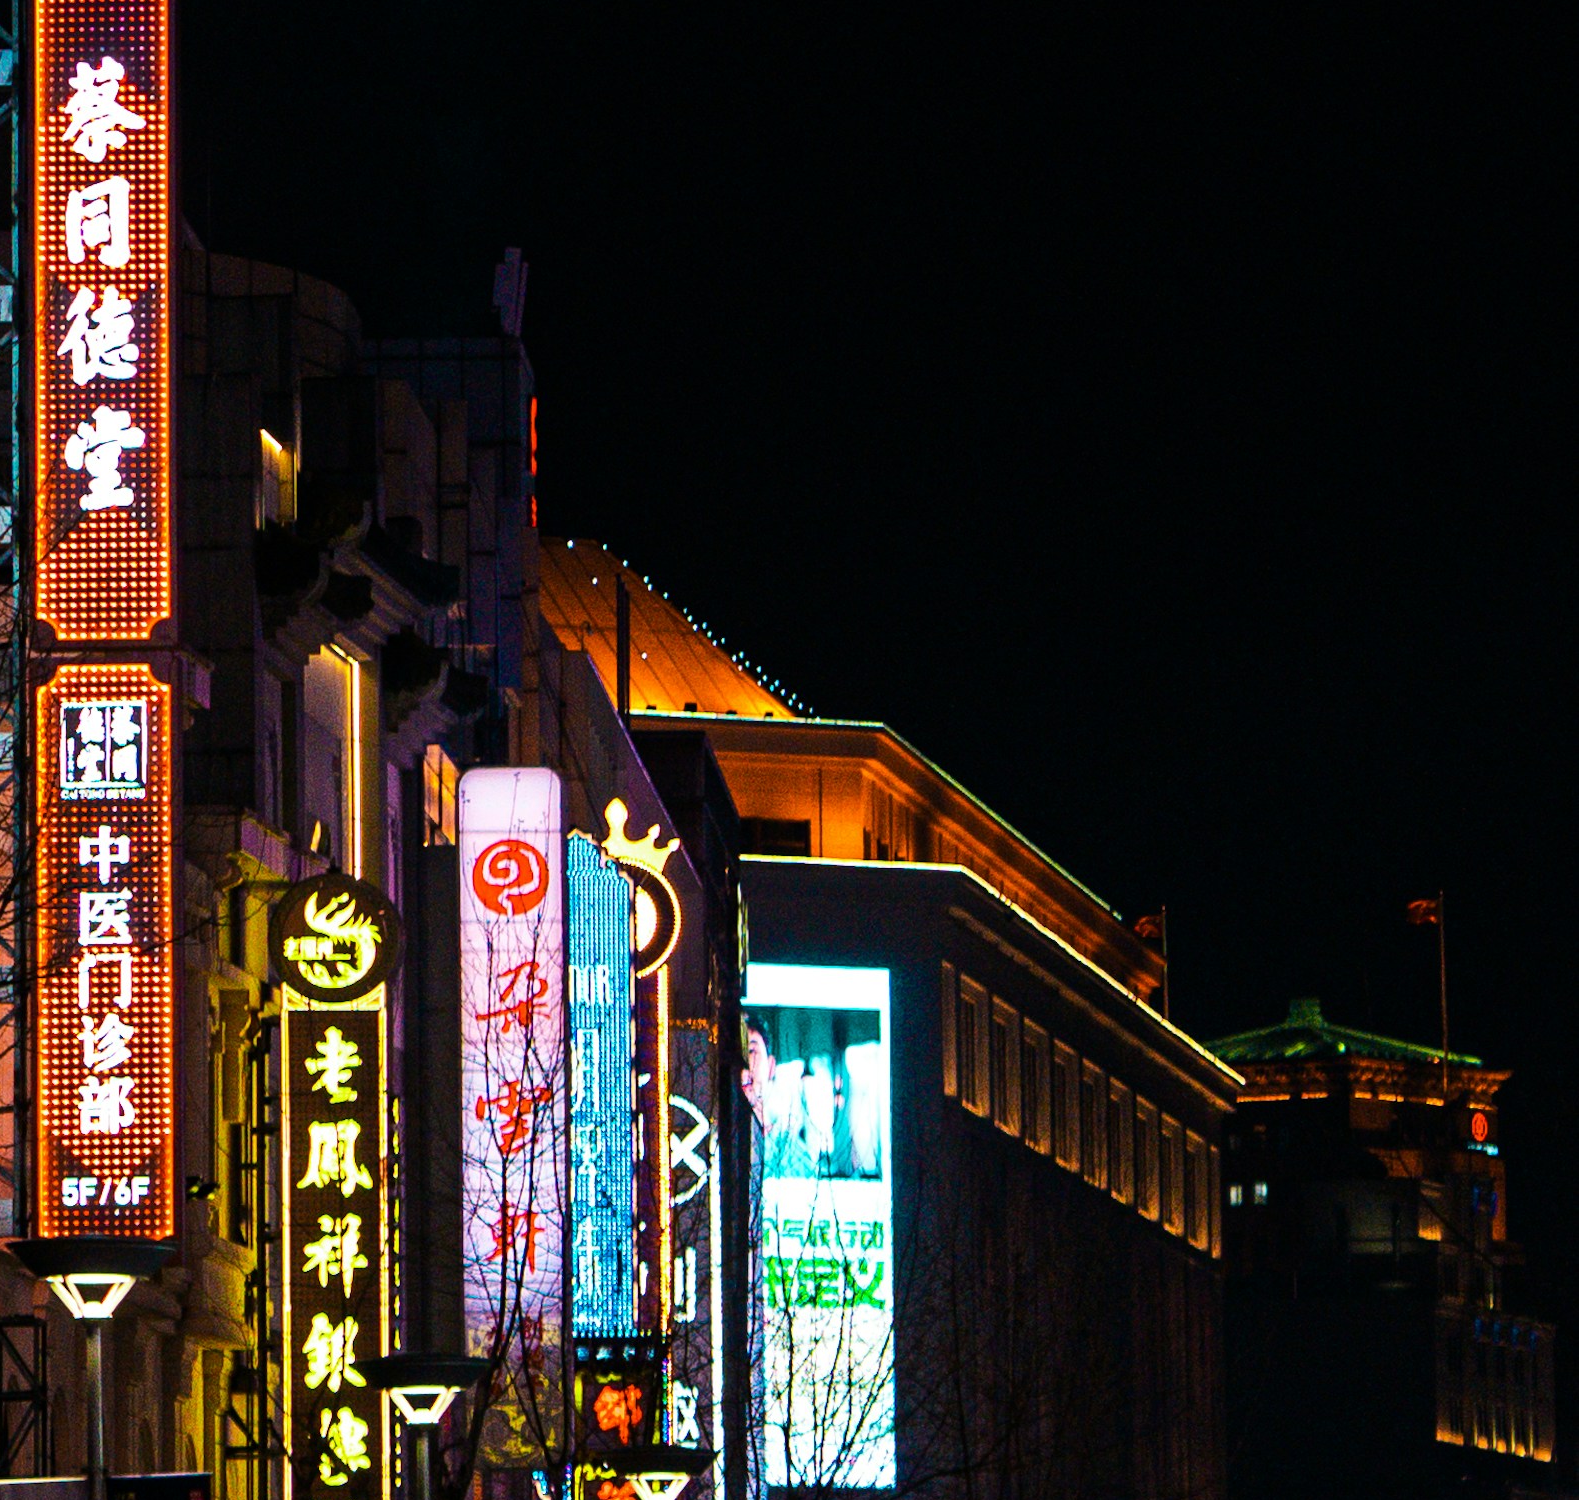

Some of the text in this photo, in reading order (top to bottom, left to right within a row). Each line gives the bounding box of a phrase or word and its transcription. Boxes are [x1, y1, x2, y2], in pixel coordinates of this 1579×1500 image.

[57, 56, 146, 511] 蔡同德堂
[75, 824, 136, 1138] 中医门诊部
[61, 1174, 148, 1208] 5F/6F
